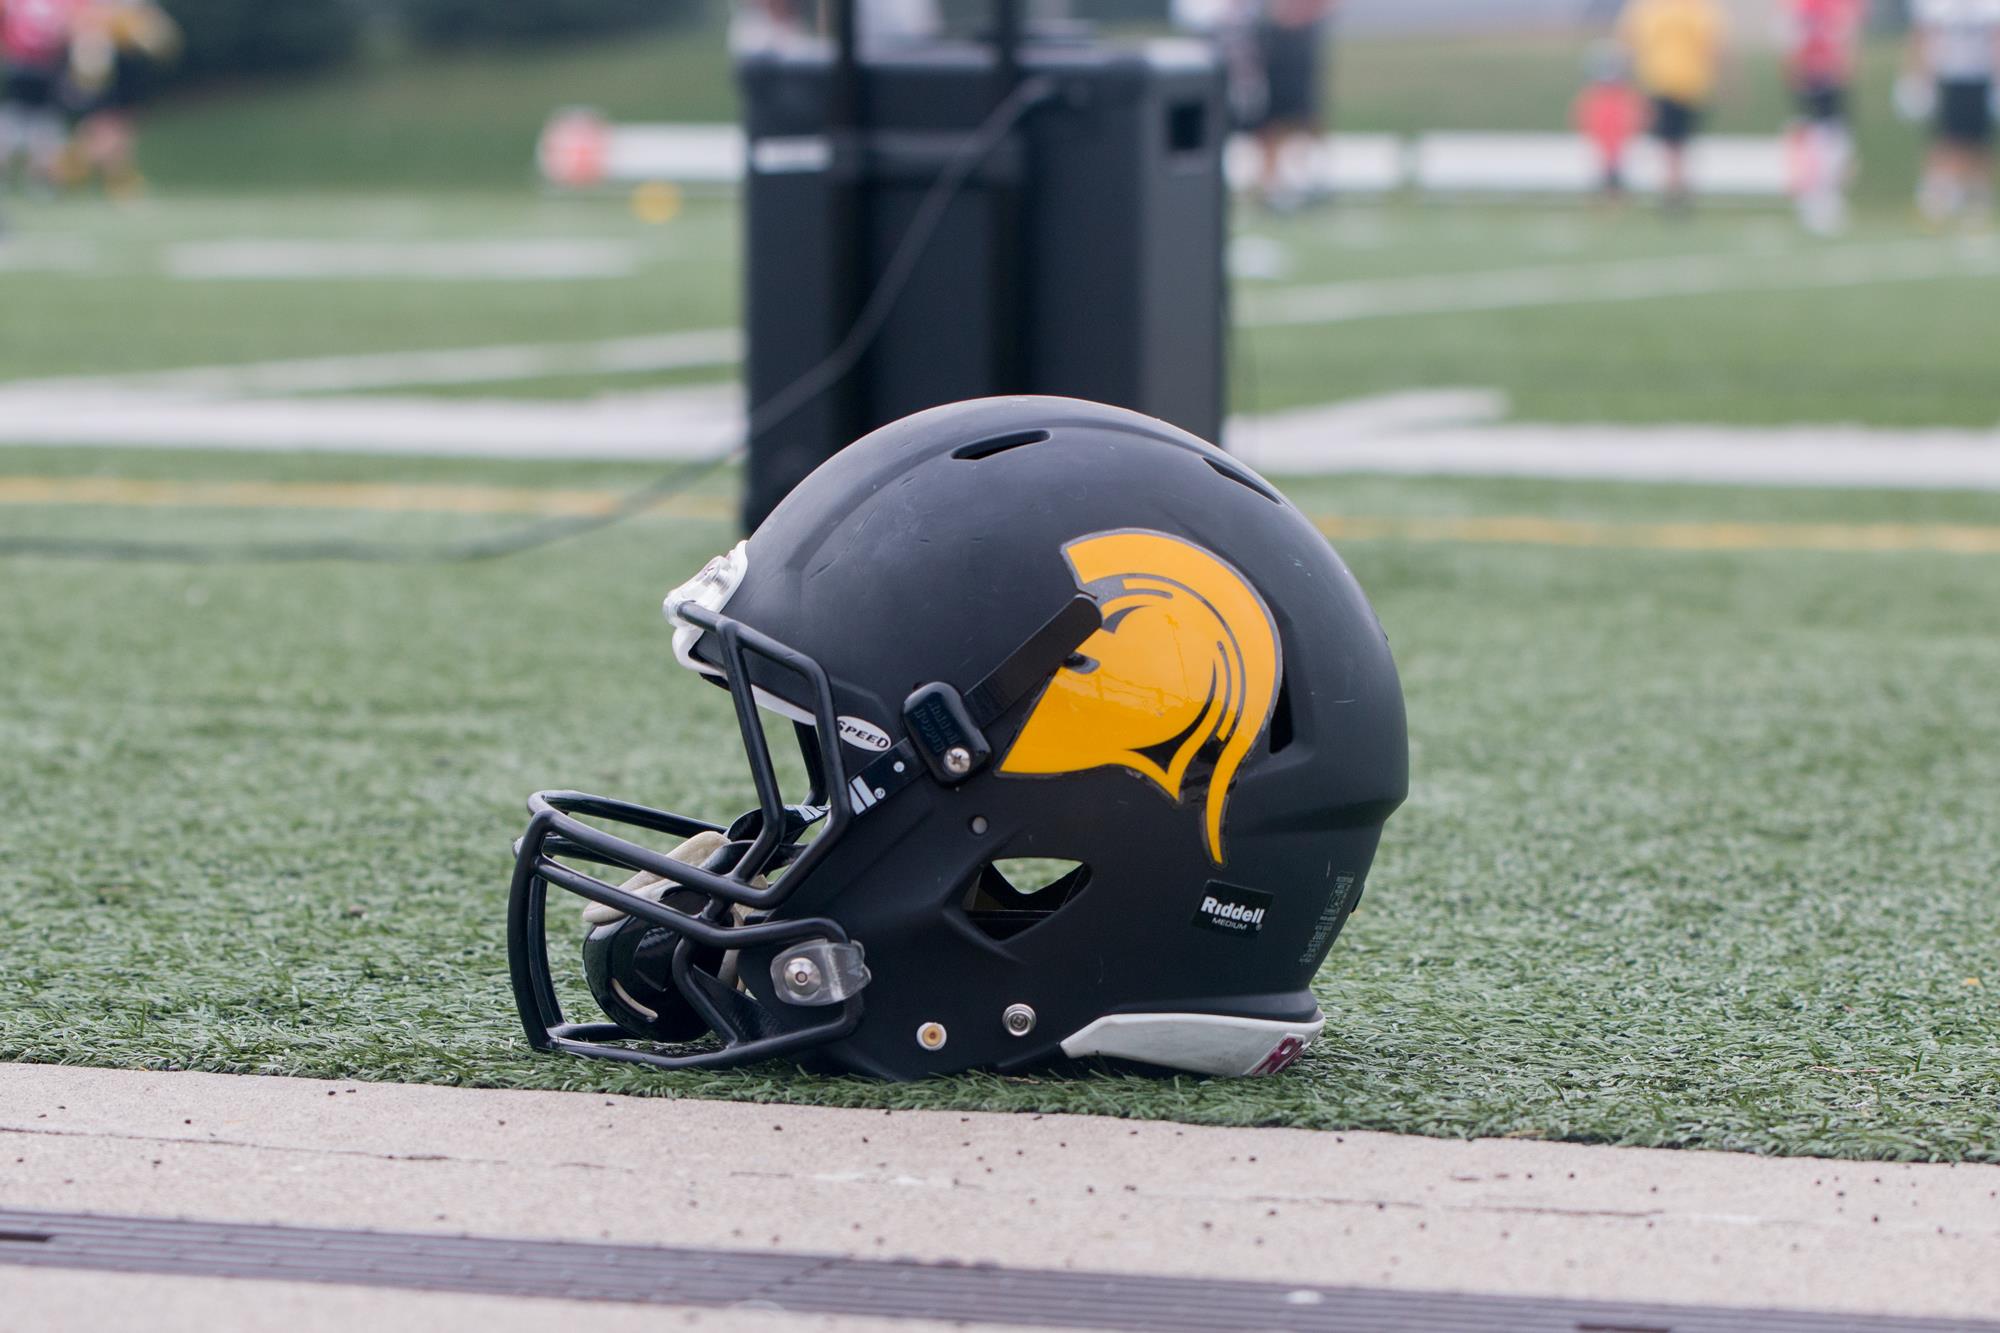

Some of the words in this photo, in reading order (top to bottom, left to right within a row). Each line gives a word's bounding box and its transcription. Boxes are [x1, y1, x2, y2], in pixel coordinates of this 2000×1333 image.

[838, 720, 889, 748] SPEED
[1201, 896, 1265, 924] Riddell
[1212, 917, 1247, 930] MEDIUM
